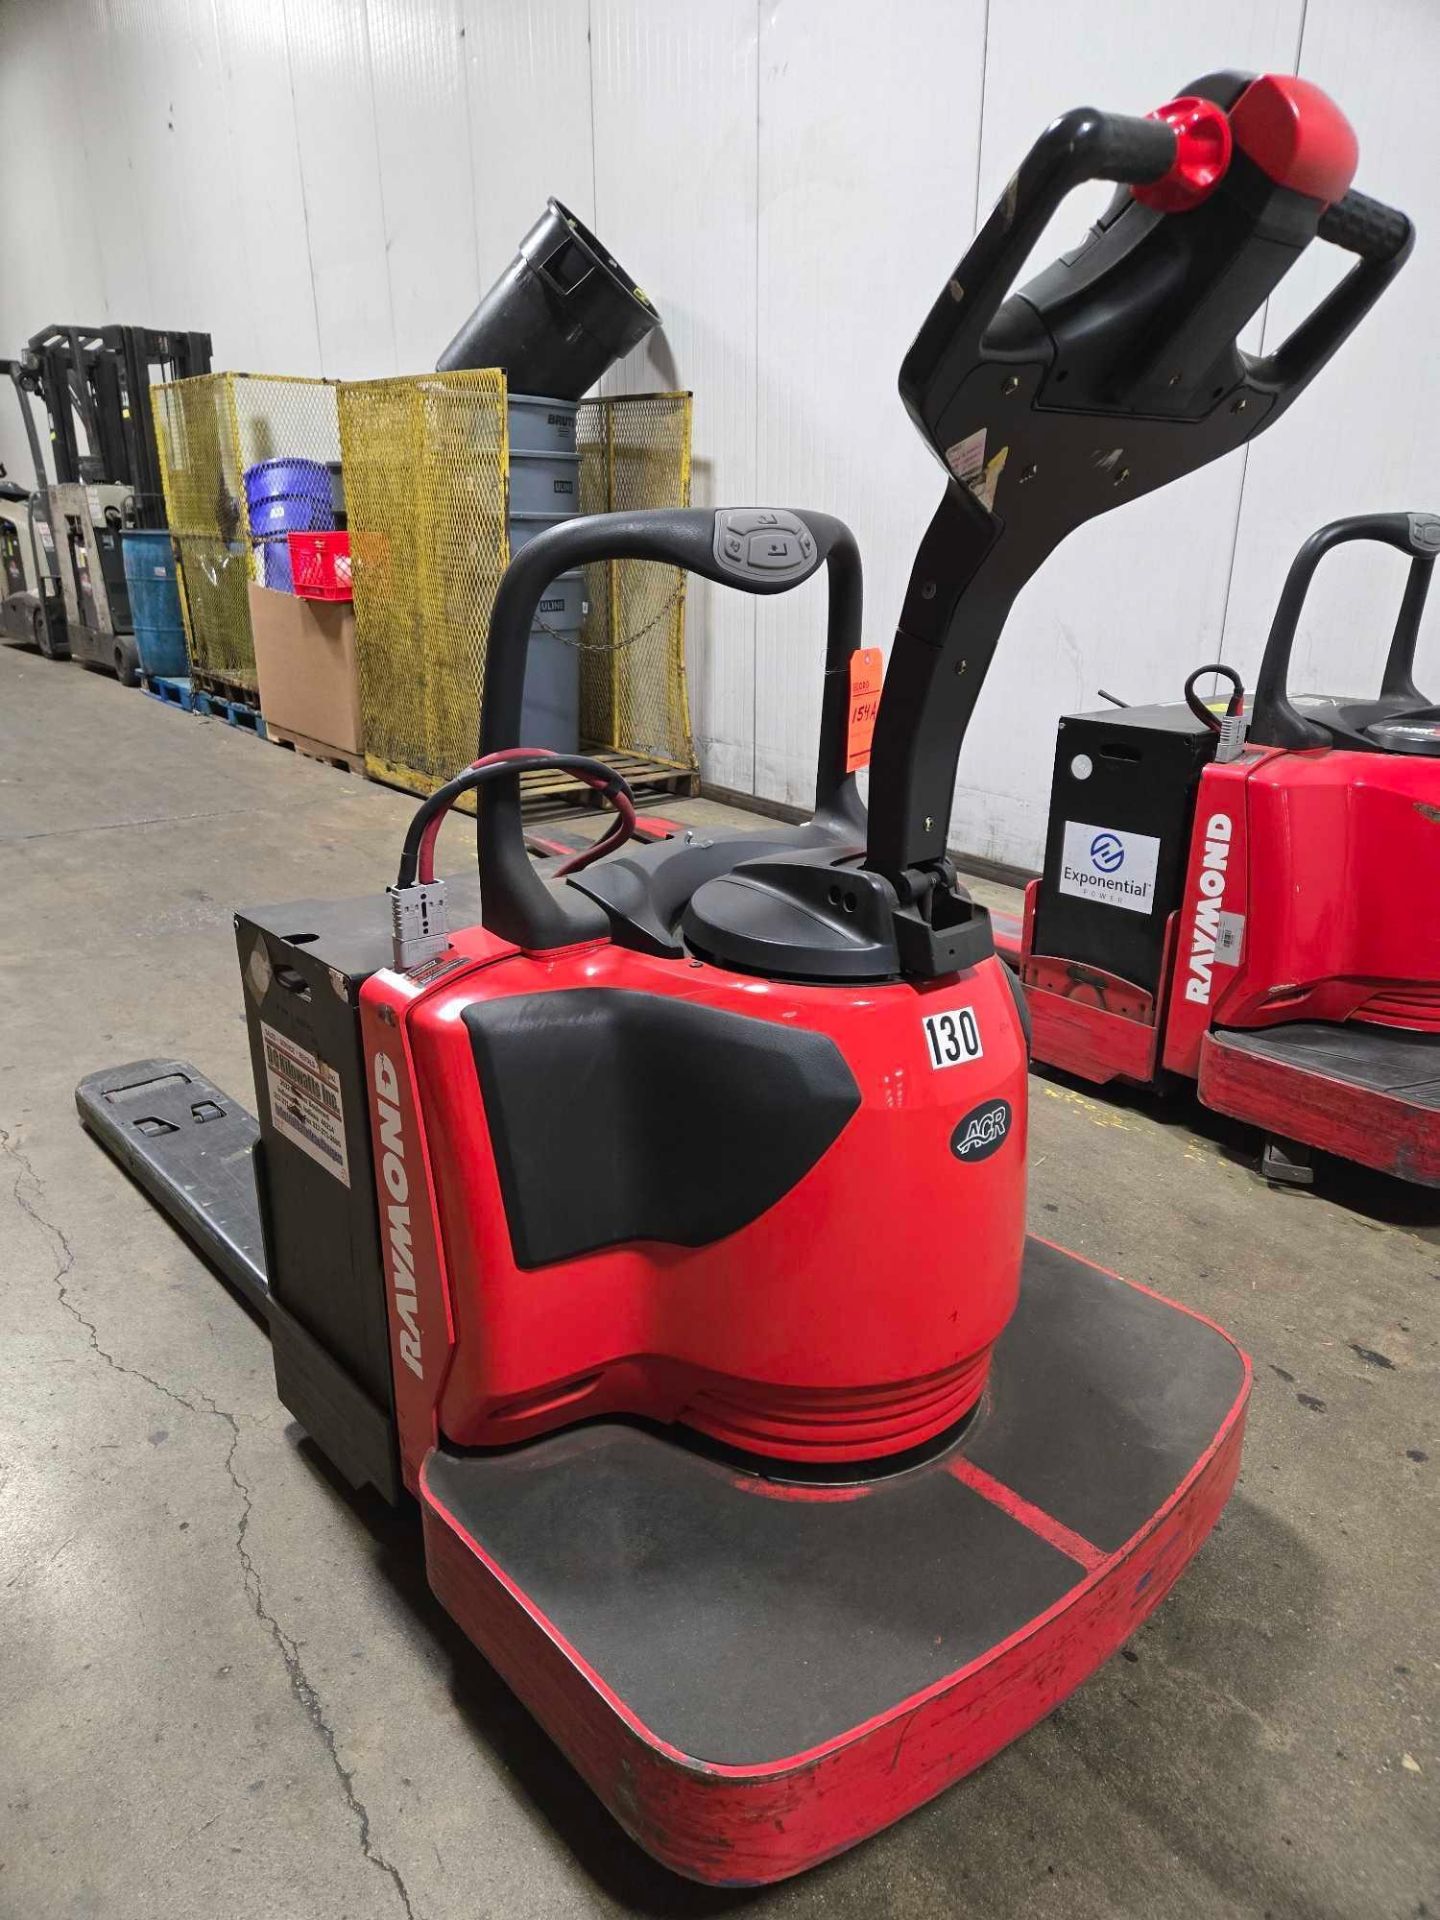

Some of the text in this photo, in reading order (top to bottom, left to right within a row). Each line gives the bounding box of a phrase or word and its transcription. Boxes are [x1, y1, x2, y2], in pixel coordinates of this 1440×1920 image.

[1064, 866, 1147, 897] Exponential
[1186, 814, 1232, 1005] RAYMOND
[926, 1010, 979, 1065] 130
[957, 1106, 1006, 1154] ACR
[374, 1052, 424, 1380] RAYMOND
